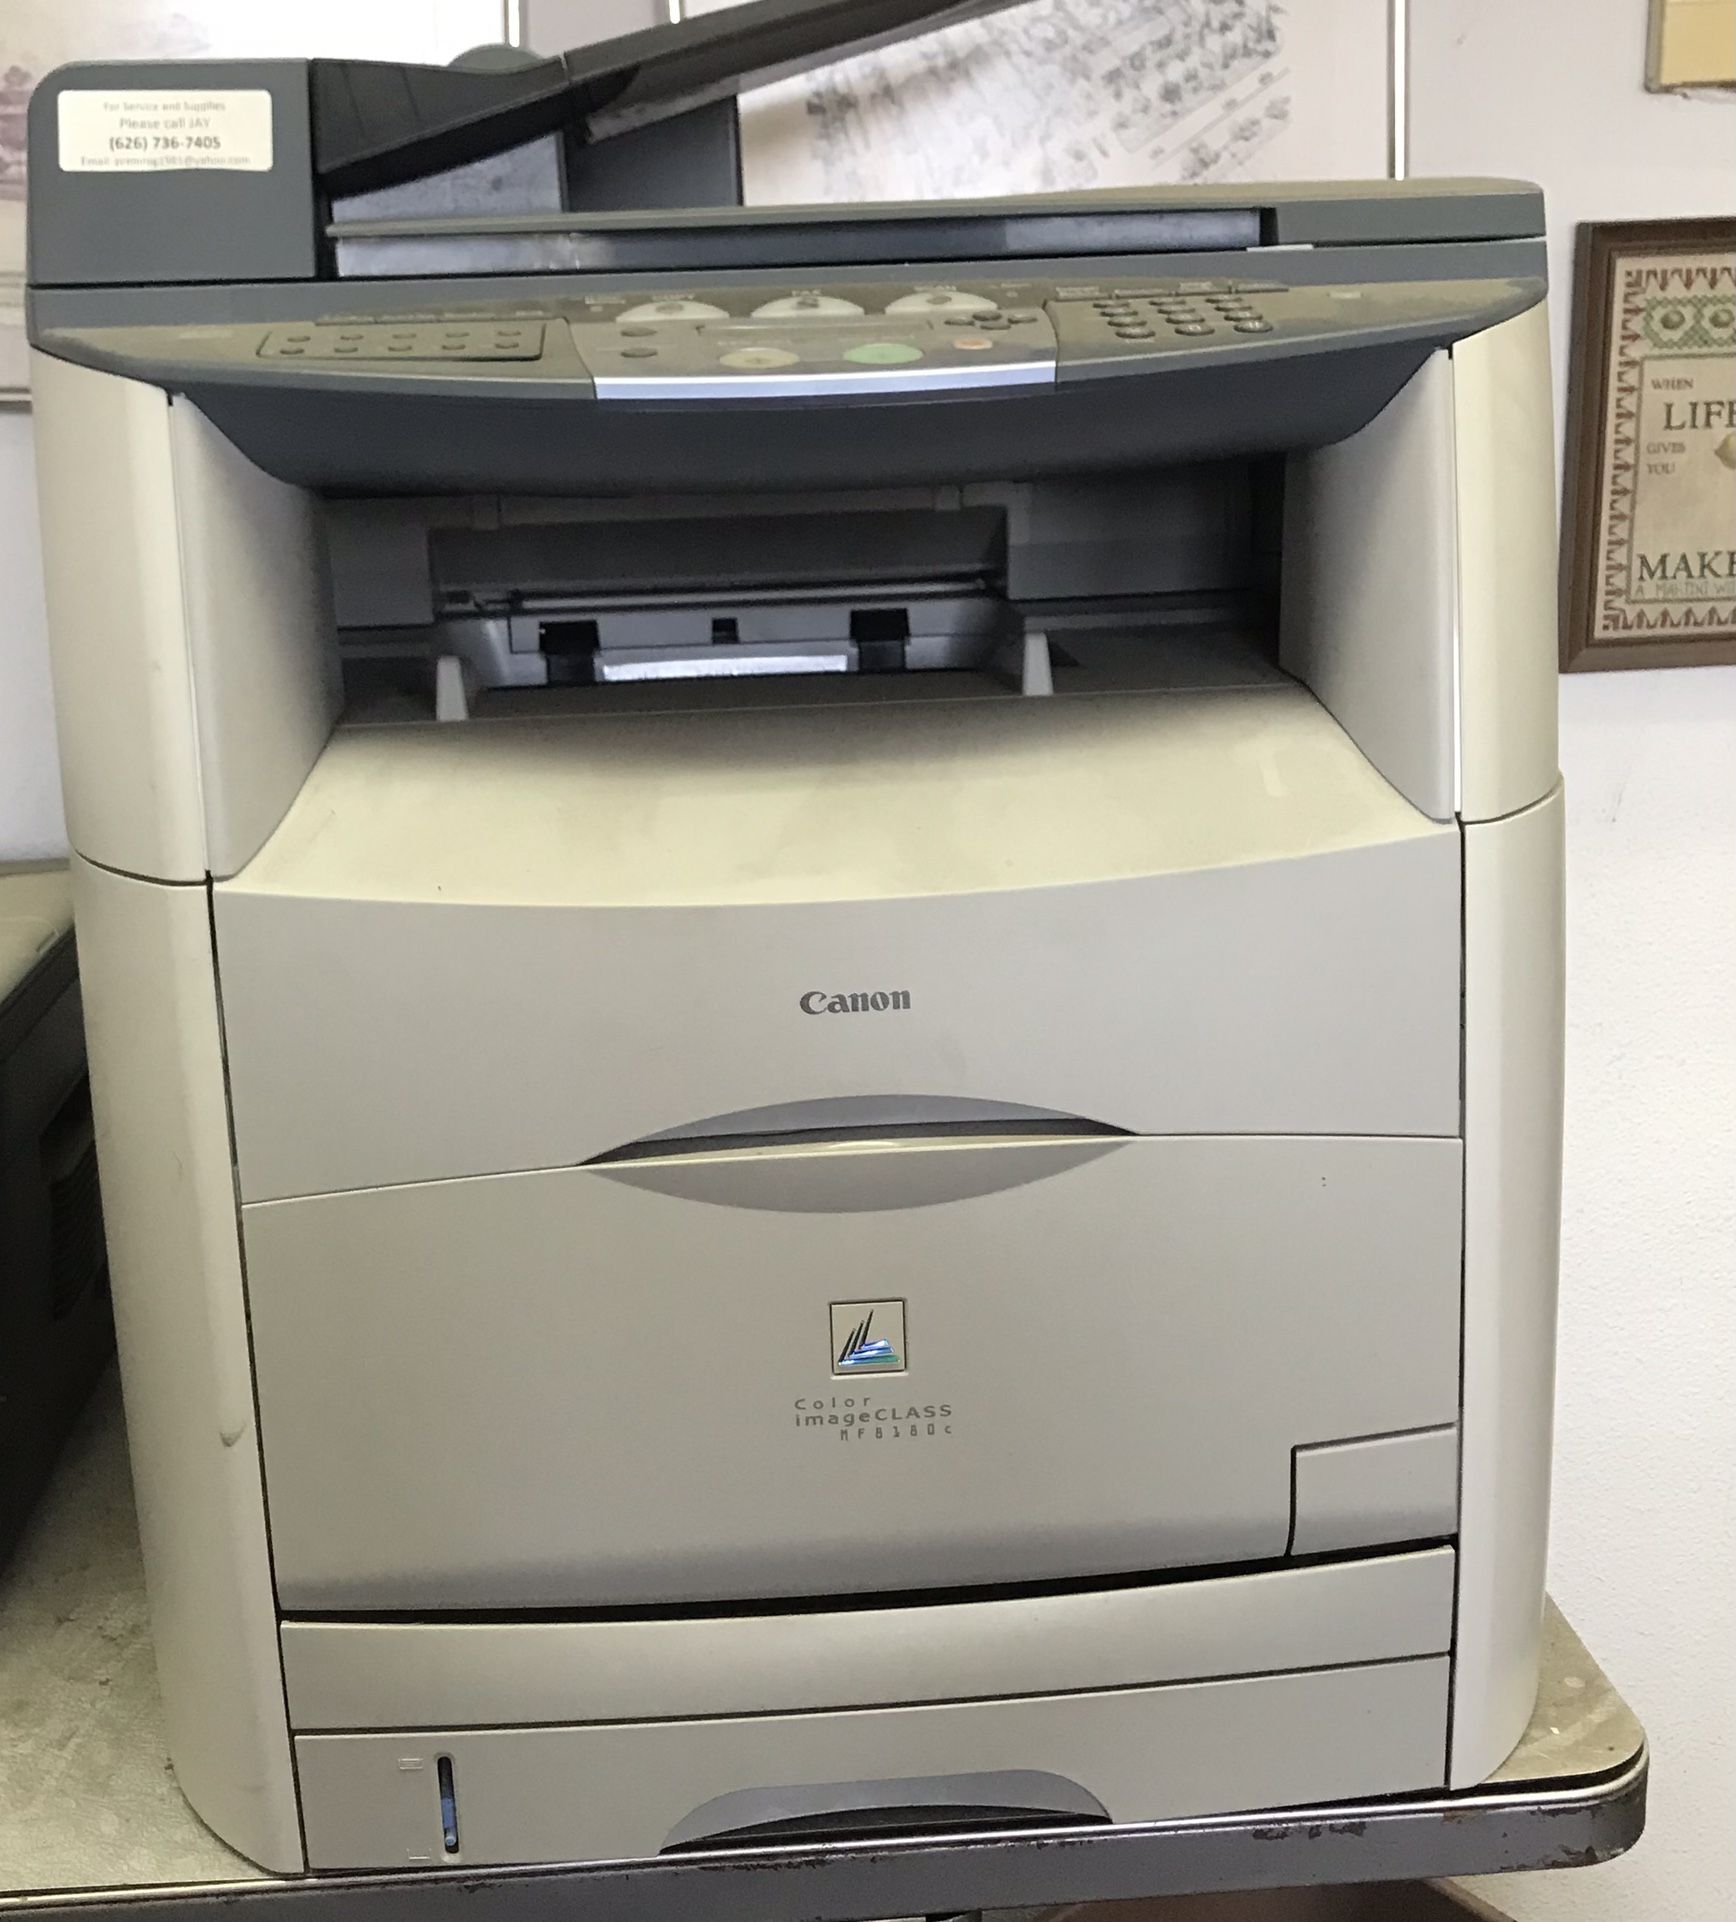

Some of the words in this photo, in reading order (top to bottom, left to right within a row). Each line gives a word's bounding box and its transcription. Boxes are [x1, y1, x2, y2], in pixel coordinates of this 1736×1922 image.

[104, 101, 120, 111] For
[123, 101, 158, 111] Service
[162, 101, 181, 111] and
[184, 100, 226, 113] Supplies
[120, 117, 160, 129] Please
[164, 117, 186, 129] call
[189, 117, 211, 129] JAY
[109, 136, 149, 151] (626)
[153, 135, 221, 150] 736-7405
[1651, 378, 1694, 391] WHEN
[1646, 441, 1686, 454] GIVES
[1646, 462, 1676, 475] YOU
[799, 990, 911, 1015] Canon
[794, 1396, 872, 1411] Color
[795, 1404, 953, 1428] imageCLASS
[840, 1423, 953, 1442] MF8180c
